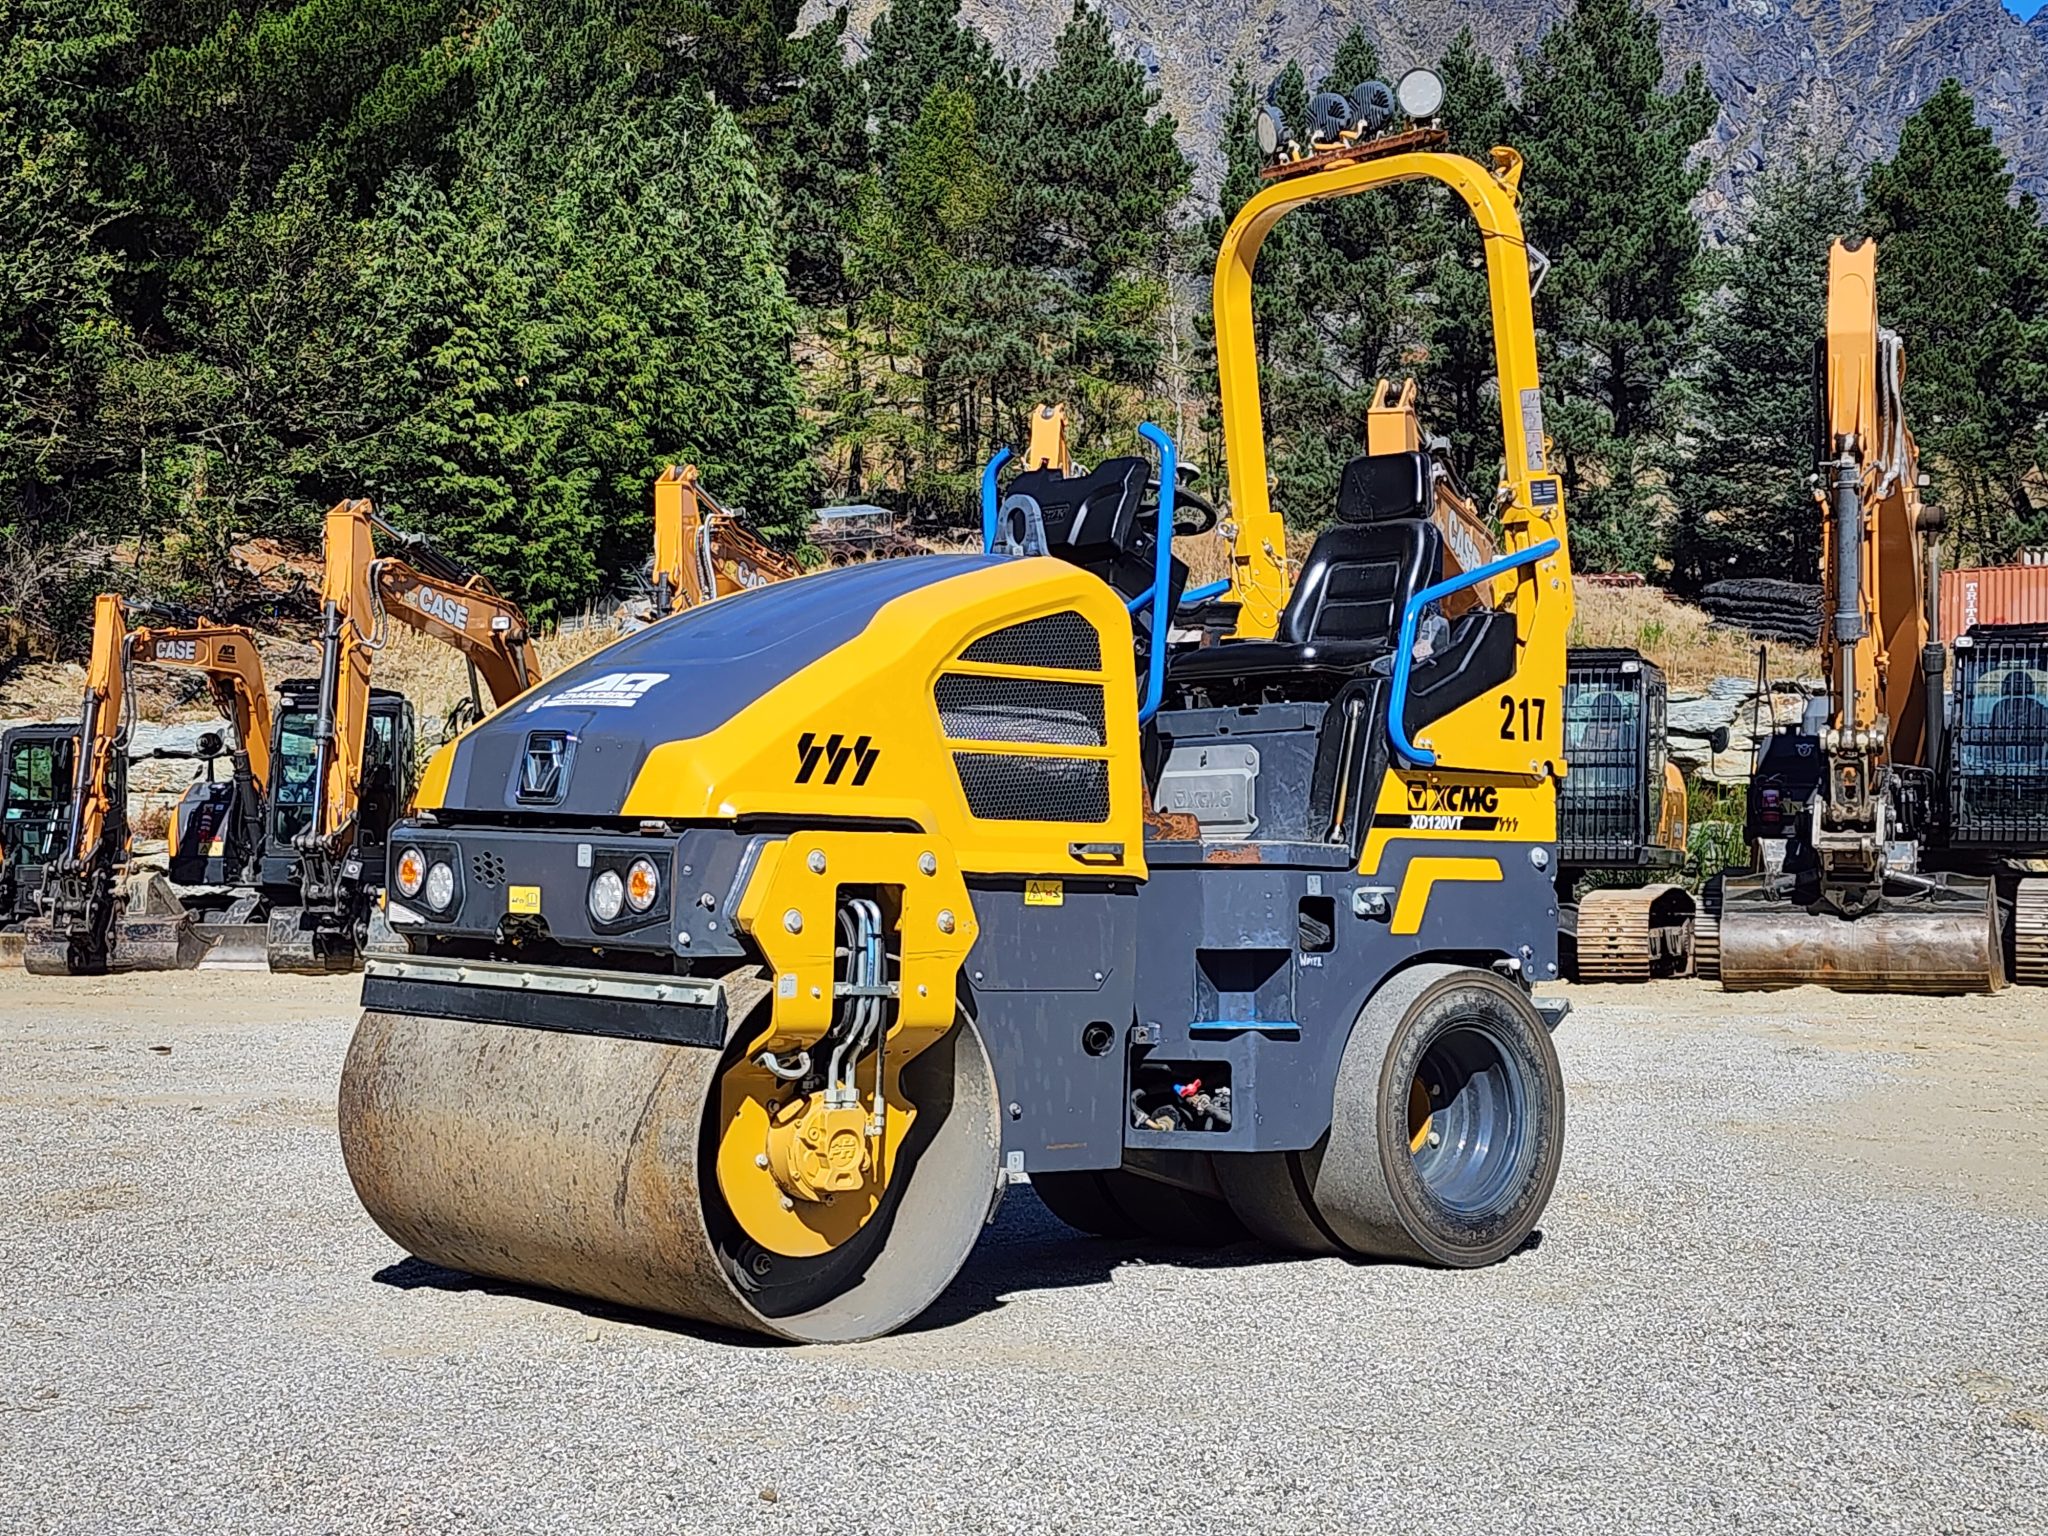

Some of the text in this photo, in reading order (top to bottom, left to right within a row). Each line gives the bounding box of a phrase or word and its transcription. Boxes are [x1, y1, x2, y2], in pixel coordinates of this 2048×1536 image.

[738, 561, 768, 589] CA
[419, 585, 469, 631] CASE
[1965, 582, 1978, 629] TRITO
[155, 639, 196, 660] CASE
[1500, 695, 1545, 742] 217
[1429, 784, 1499, 813] XCMG
[1409, 814, 1464, 830] XD120VT
